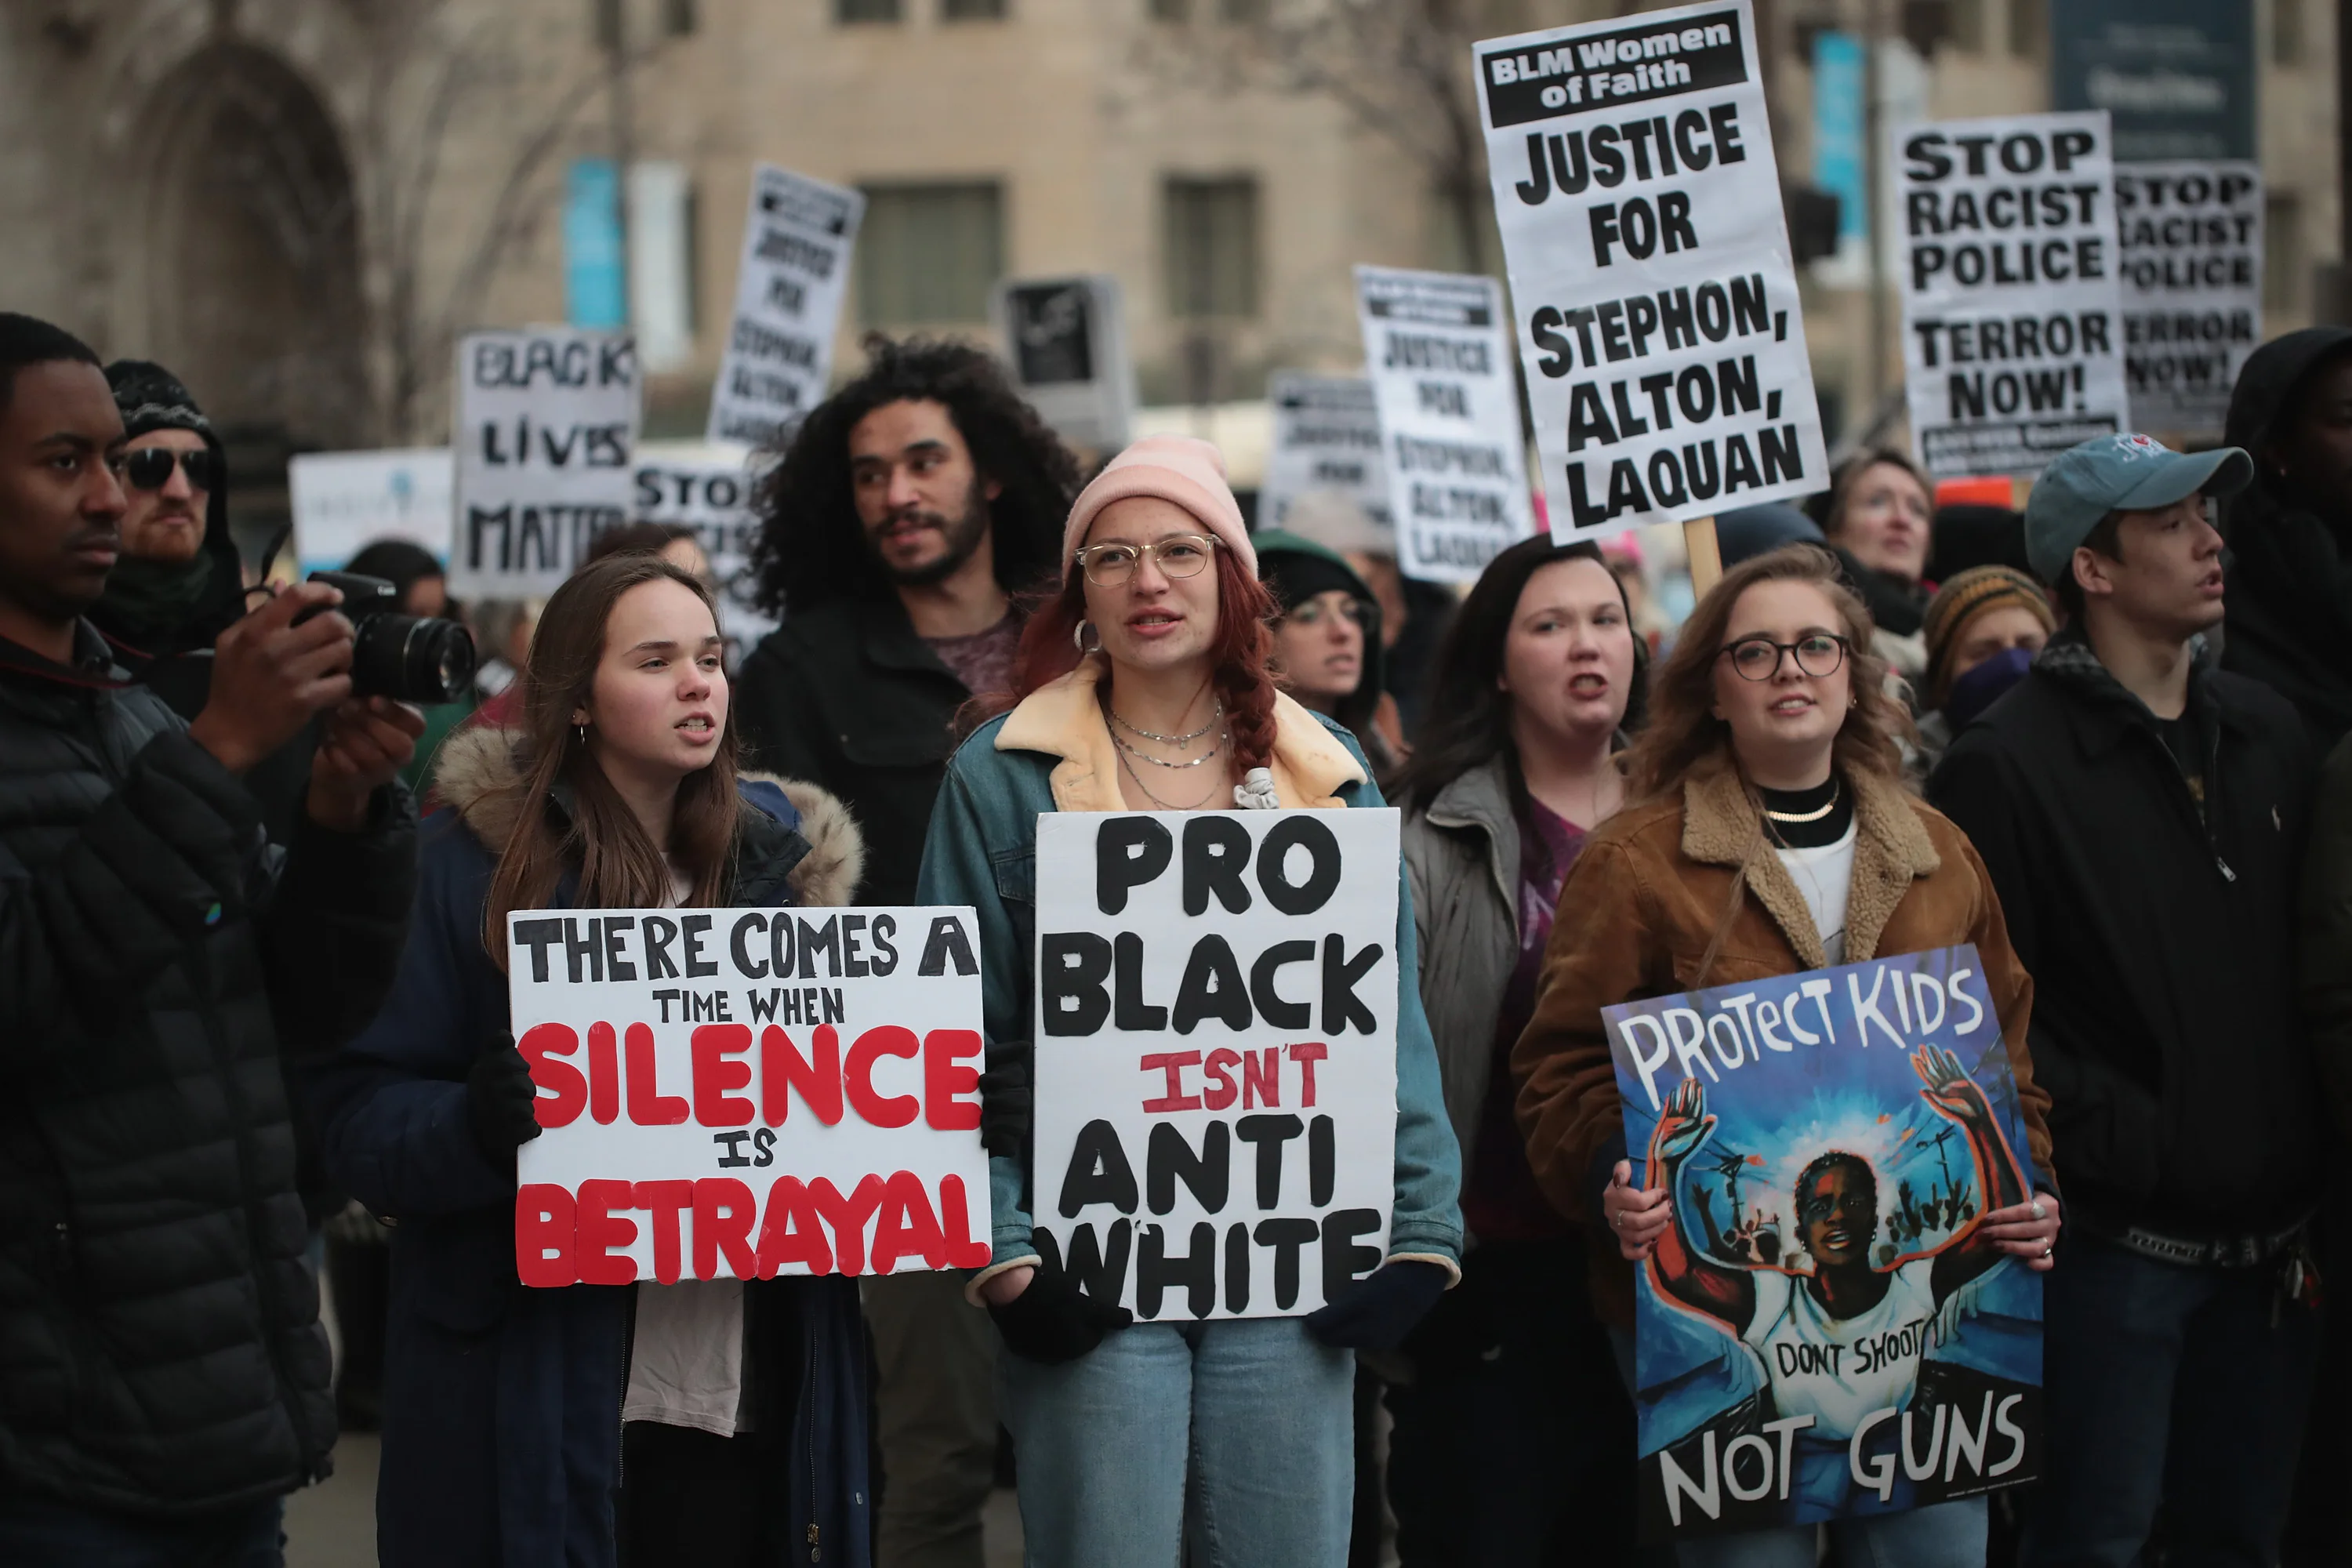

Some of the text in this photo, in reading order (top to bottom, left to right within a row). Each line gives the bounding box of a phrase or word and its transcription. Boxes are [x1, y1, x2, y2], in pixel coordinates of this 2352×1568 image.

[1491, 23, 1731, 85] BLM Women
[1541, 59, 1691, 108] of Faith
[1515, 102, 1746, 205] JUSTICE
[1905, 130, 2096, 182] STOP
[1588, 191, 1699, 267] FOR
[1907, 185, 2099, 236] RACIST
[1912, 240, 2105, 291] POLICE
[1531, 273, 1788, 378] STEPHON,
[1914, 314, 2111, 368] TERROR
[2124, 309, 2252, 345] ERROR
[475, 339, 636, 387] BLACK
[1948, 365, 2085, 419] NOW!
[1567, 355, 1782, 453] ALTON,
[636, 469, 754, 507] STO
[1566, 424, 1805, 528] LAQUAN
[1096, 815, 1341, 916] PRO
[514, 913, 979, 983] THERE COMES A
[652, 987, 844, 1025] TIME WHEN
[1042, 931, 1384, 1036] BLACK
[1847, 964, 1984, 1050] KIDS
[515, 1021, 982, 1130] SILENCE
[1140, 1043, 1328, 1113] ISN'T
[713, 1127, 778, 1167] IS
[1058, 1113, 1335, 1218] ANTI
[515, 1171, 992, 1287] BETRAYAL
[1033, 1208, 1382, 1319] WHITE
[1777, 1319, 1924, 1377] DONT SHOOT
[1660, 1389, 2025, 1526] NOT GUNS
